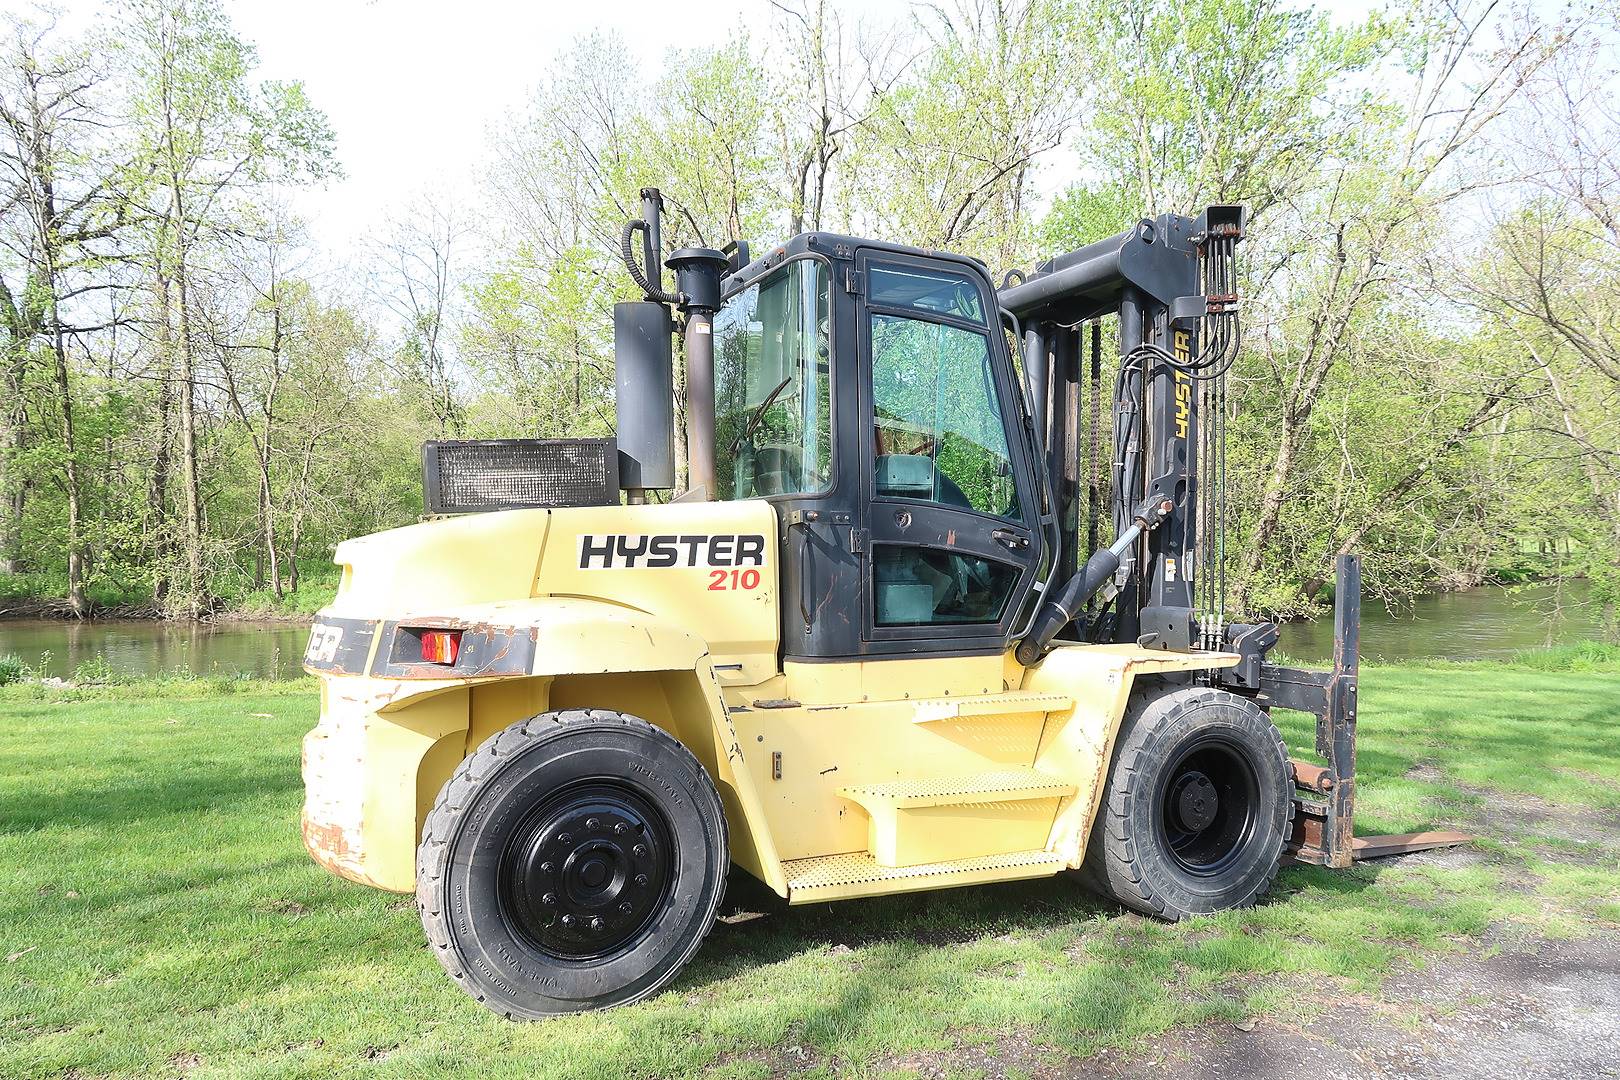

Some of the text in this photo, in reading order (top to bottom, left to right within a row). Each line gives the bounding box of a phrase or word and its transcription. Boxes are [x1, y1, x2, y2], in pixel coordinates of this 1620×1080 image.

[1174, 331, 1190, 440] HYSTER
[580, 535, 765, 568] HYSTER
[708, 569, 761, 591] 210
[466, 783, 503, 838] 10.00-20
[454, 883, 467, 935] RIM GUARD
